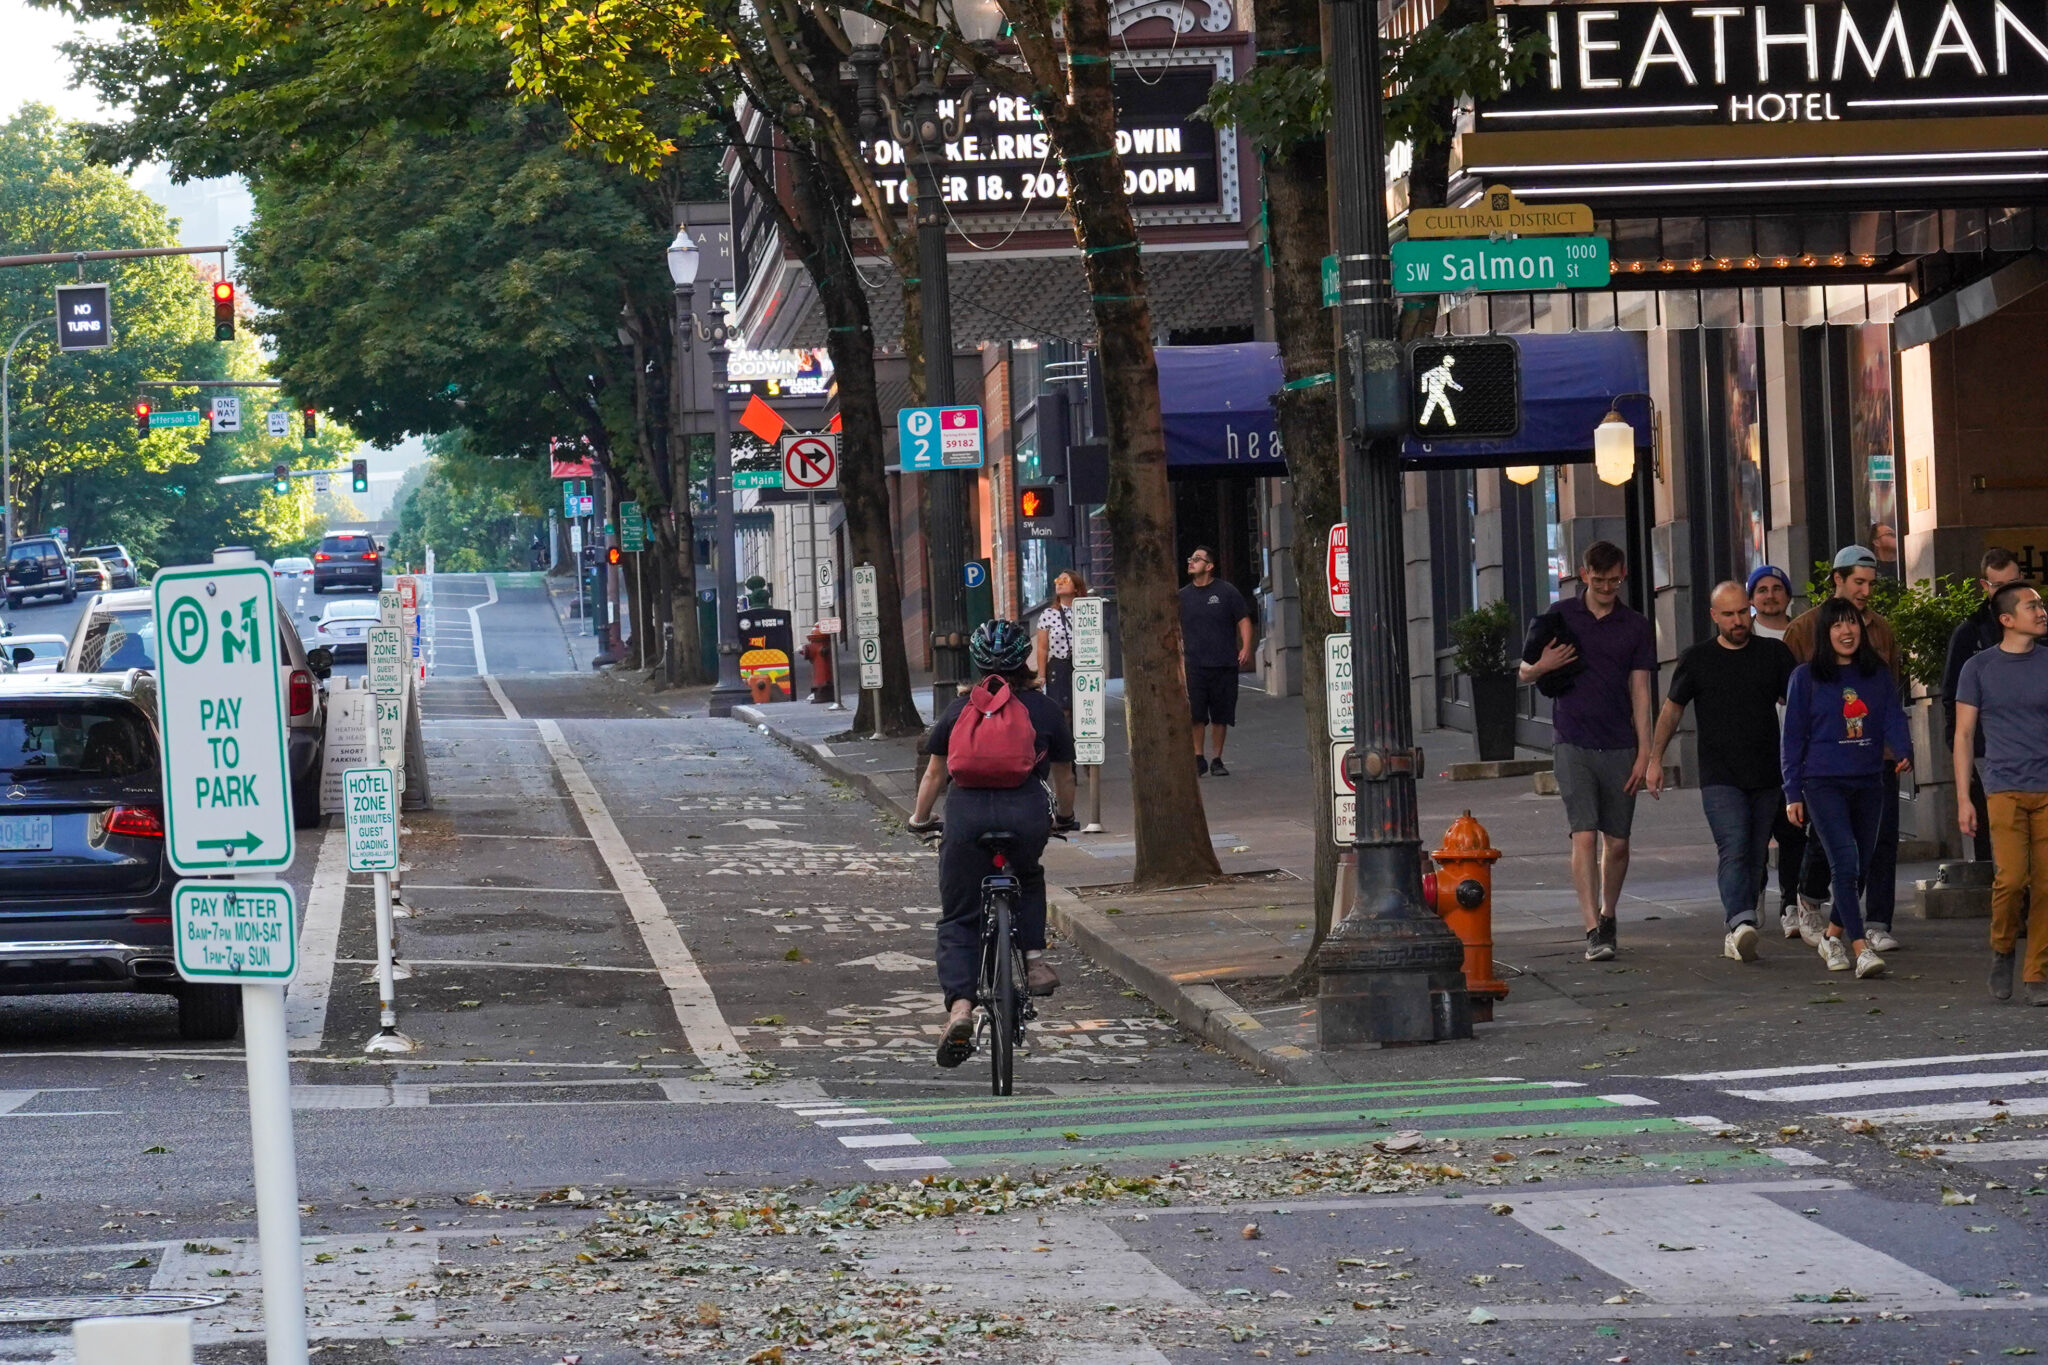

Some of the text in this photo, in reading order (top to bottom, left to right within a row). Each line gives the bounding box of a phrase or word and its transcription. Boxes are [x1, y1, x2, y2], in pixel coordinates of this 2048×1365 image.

[1731, 93, 1840, 122] HOTEL
[1425, 212, 1577, 231] CULTURAL DISTRICT
[1566, 244, 1597, 259] 1000
[1406, 251, 1580, 282] SW Salmon St
[74, 304, 91, 315] NO
[67, 320, 101, 332] TURNS
[730, 360, 798, 376] OODWIN
[217, 399, 235, 408] ONE
[187, 414, 196, 423] St
[216, 409, 236, 417] WAY
[914, 415, 927, 432] P
[914, 439, 931, 462] 2
[946, 439, 974, 448] 59182
[750, 475, 774, 486] Main
[1031, 528, 1052, 536] Main
[1332, 529, 1344, 547] NO
[822, 569, 828, 580] P
[966, 566, 979, 584] P
[1076, 604, 1099, 615] HOTEL
[1078, 616, 1097, 628] ZONE
[178, 610, 200, 651] P
[372, 632, 399, 643] HOTEL
[374, 644, 397, 656] ZONE
[866, 644, 874, 658] P
[1336, 662, 1352, 678] ZO
[1082, 700, 1094, 708] PAY
[200, 697, 242, 731] PAY
[1084, 708, 1093, 716] TO
[1080, 717, 1096, 726] PARK
[208, 736, 240, 769] TO
[196, 774, 260, 809] PARK
[350, 777, 388, 794] HOTEL
[354, 796, 386, 812] ZONE
[350, 813, 393, 825] 15 MINUTES
[22, 823, 50, 842] LHP
[358, 826, 384, 838] GUEST
[355, 839, 389, 851] LOADING
[190, 898, 277, 918] PAY METER
[188, 921, 282, 942] 8AM-7PM MON-SAT
[202, 945, 270, 966] 1PM-7PM SUN
